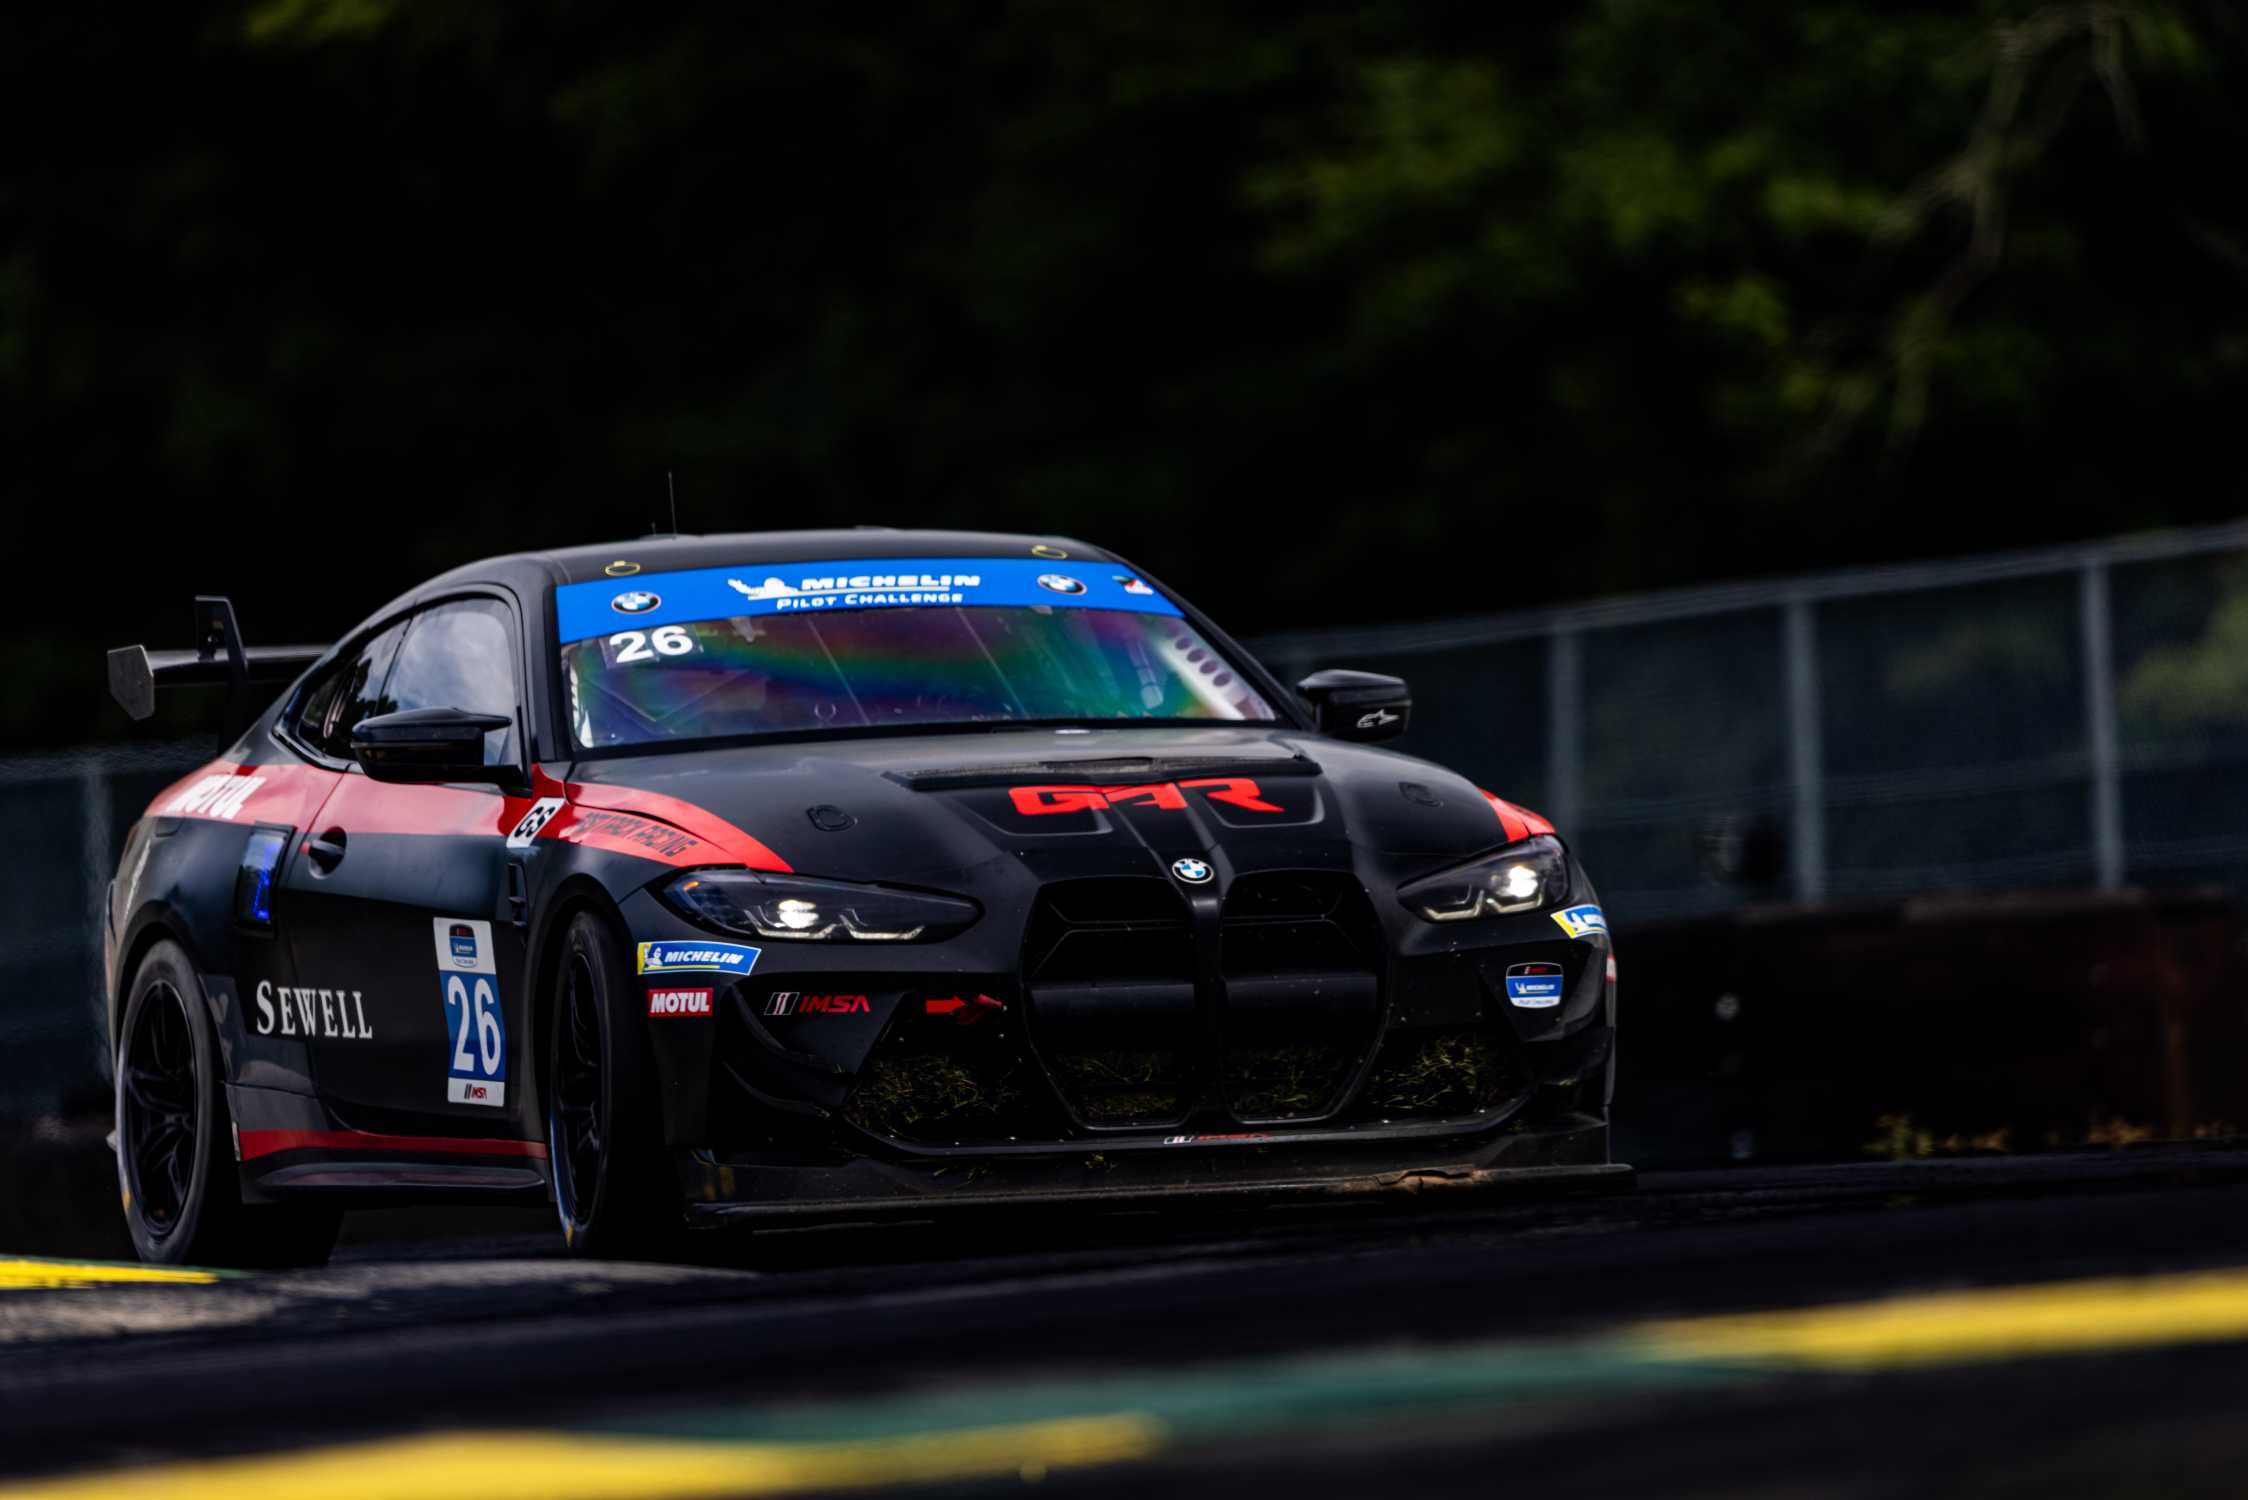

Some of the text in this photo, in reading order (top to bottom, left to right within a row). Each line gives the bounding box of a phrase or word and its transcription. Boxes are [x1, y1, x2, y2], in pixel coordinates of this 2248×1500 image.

[801, 575, 981, 590] MICHELIN
[609, 625, 693, 664] 26
[513, 806, 556, 838] GS
[664, 951, 744, 965] MICHELIN
[650, 992, 710, 1013] MOTUL
[799, 995, 871, 1013] IMSA
[447, 975, 501, 1076] 26
